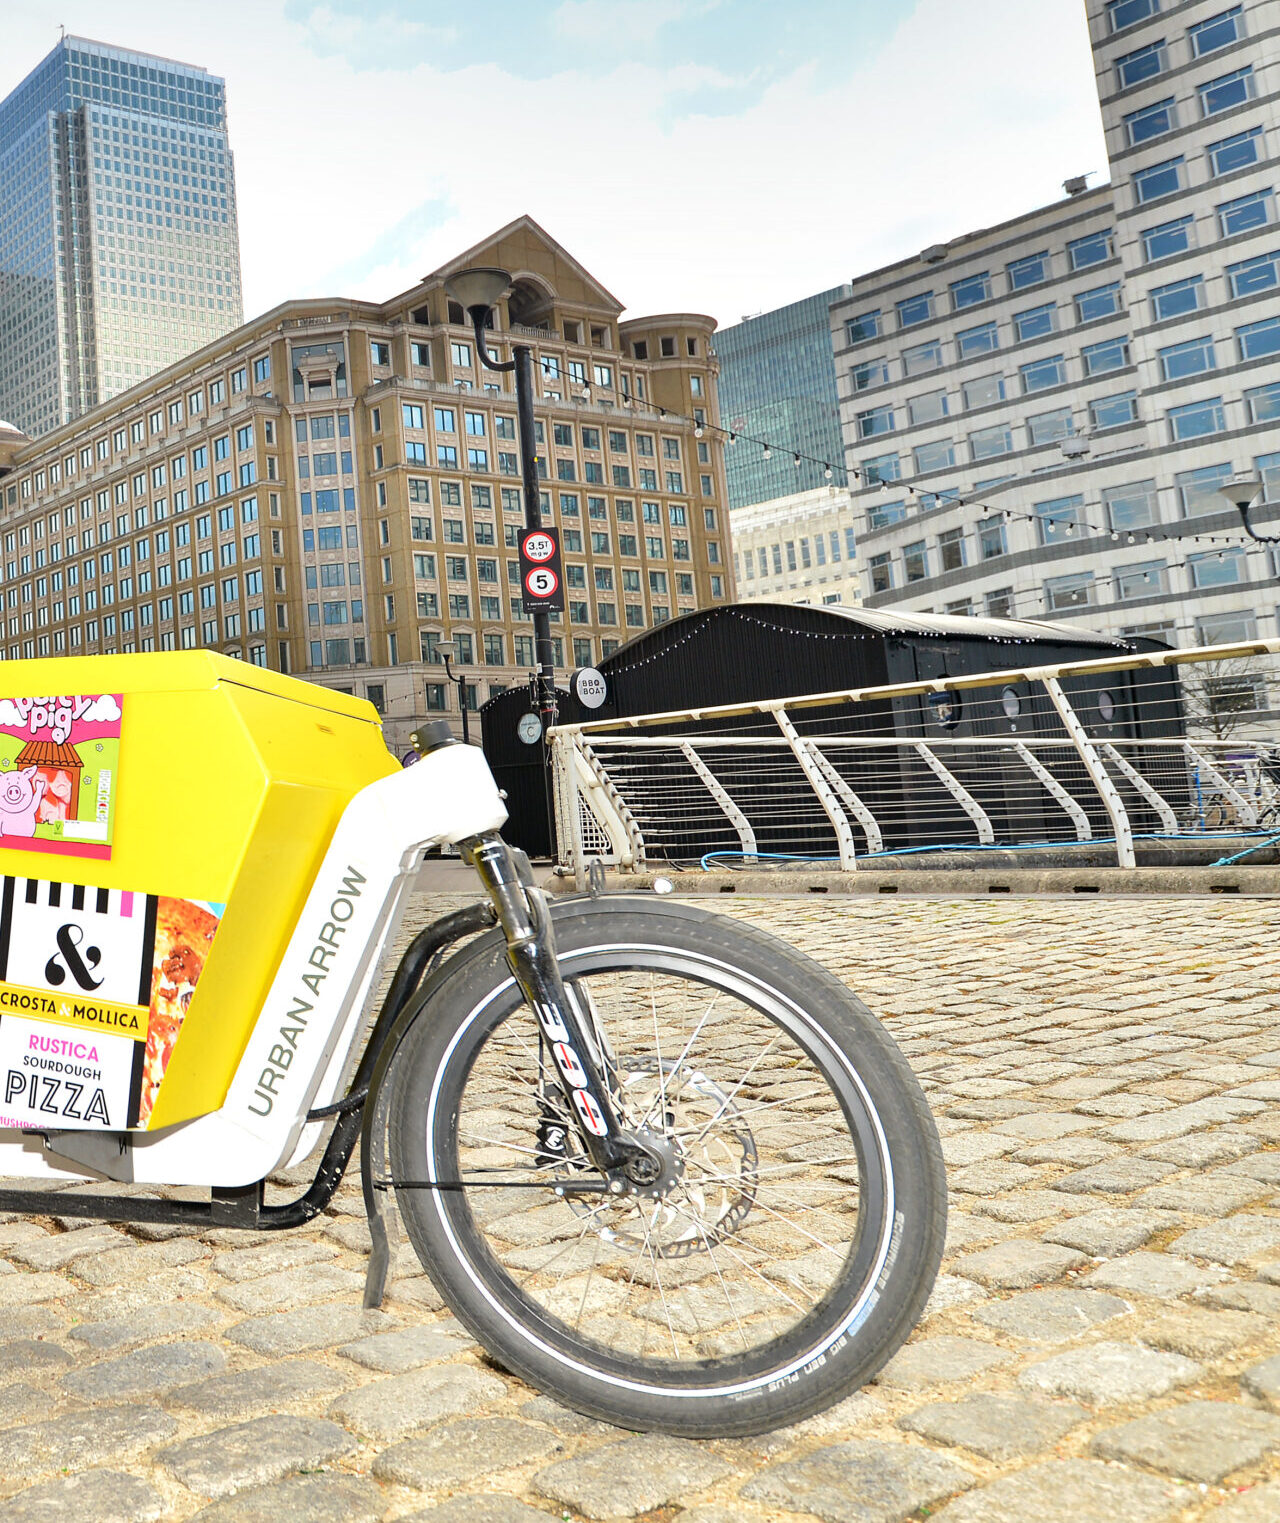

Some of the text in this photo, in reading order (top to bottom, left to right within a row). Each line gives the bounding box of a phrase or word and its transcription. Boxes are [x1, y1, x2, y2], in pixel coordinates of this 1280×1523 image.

[536, 575, 548, 589] 5
[583, 687, 605, 695] BOAT
[31, 703, 73, 745] pig
[45, 923, 105, 992] &
[248, 865, 367, 1117] URBAN ARROW
[0, 992, 57, 1014] CROSTA
[73, 1004, 139, 1030] MOLLICA
[29, 1034, 99, 1063] RUSTICA
[23, 1055, 102, 1081] SOURDOUGH
[4, 1069, 111, 1126] PIZZA
[768, 1371, 800, 1393] PLUS
